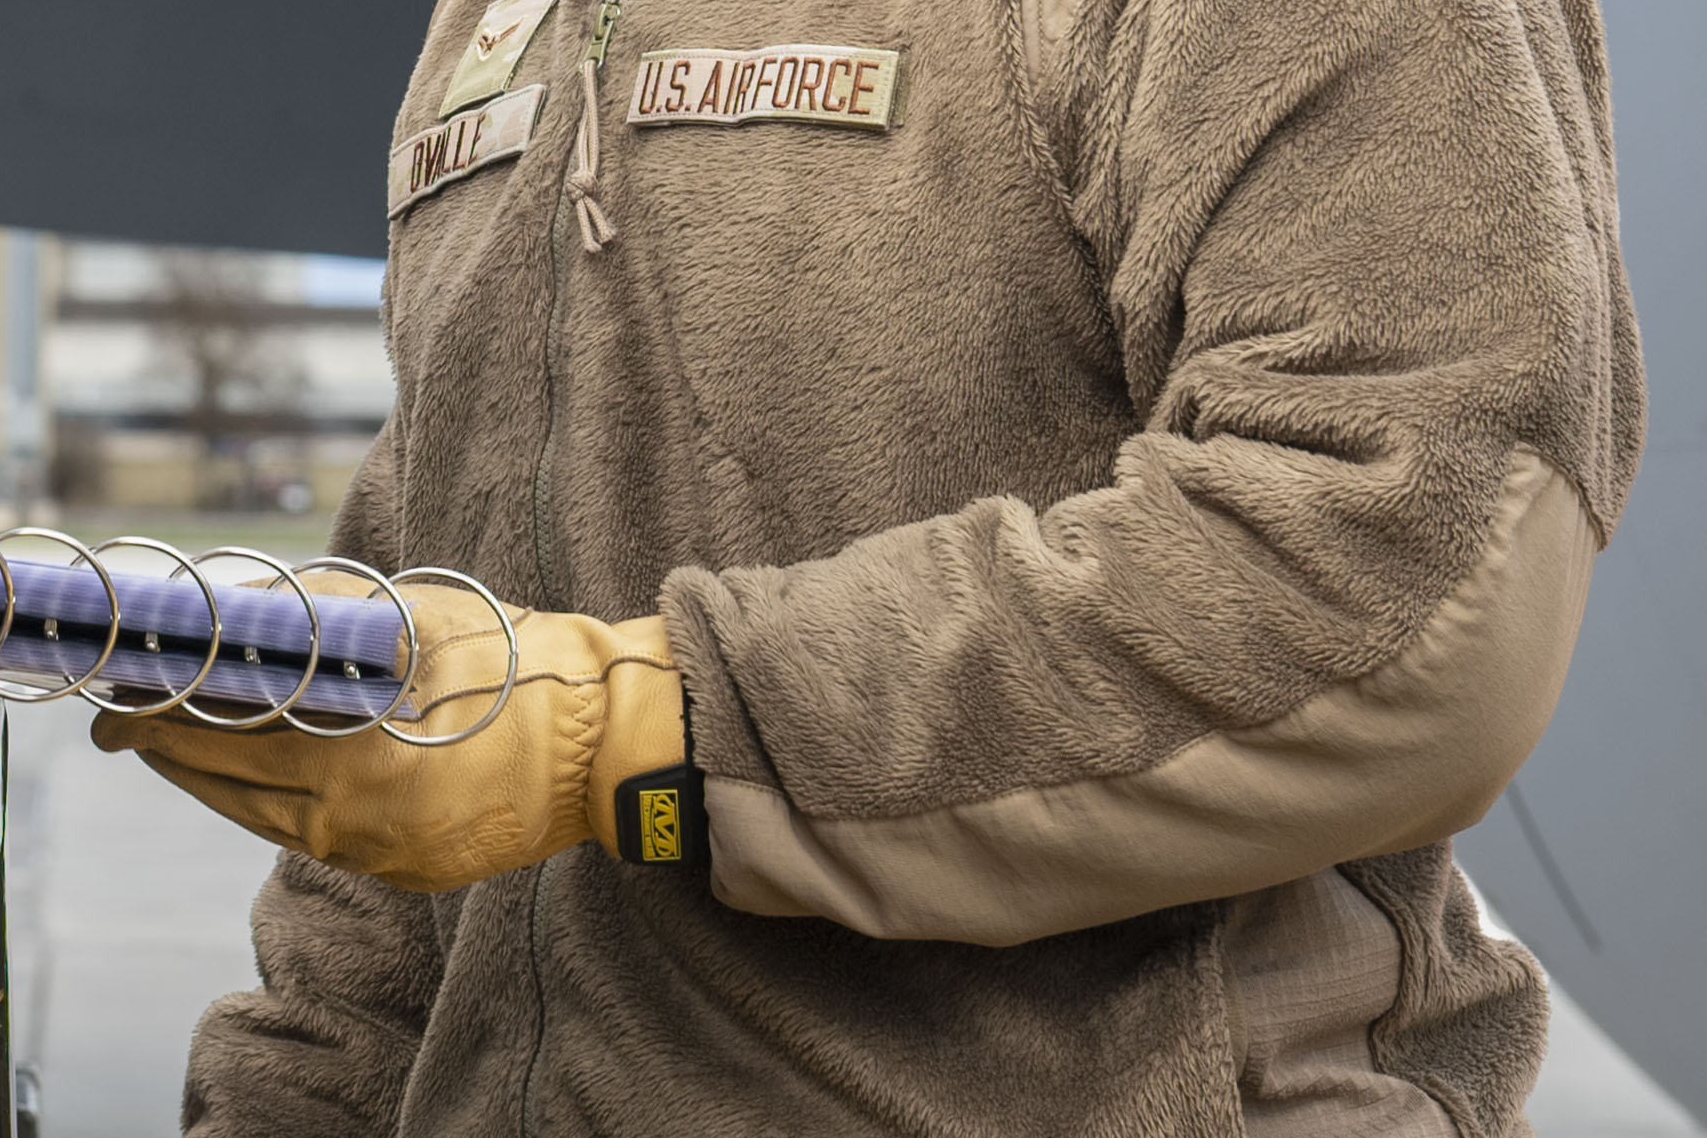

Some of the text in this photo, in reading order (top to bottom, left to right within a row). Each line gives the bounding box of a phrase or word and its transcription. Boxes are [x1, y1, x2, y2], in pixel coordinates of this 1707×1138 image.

[639, 56, 879, 115] U.S. AIR FORCE
